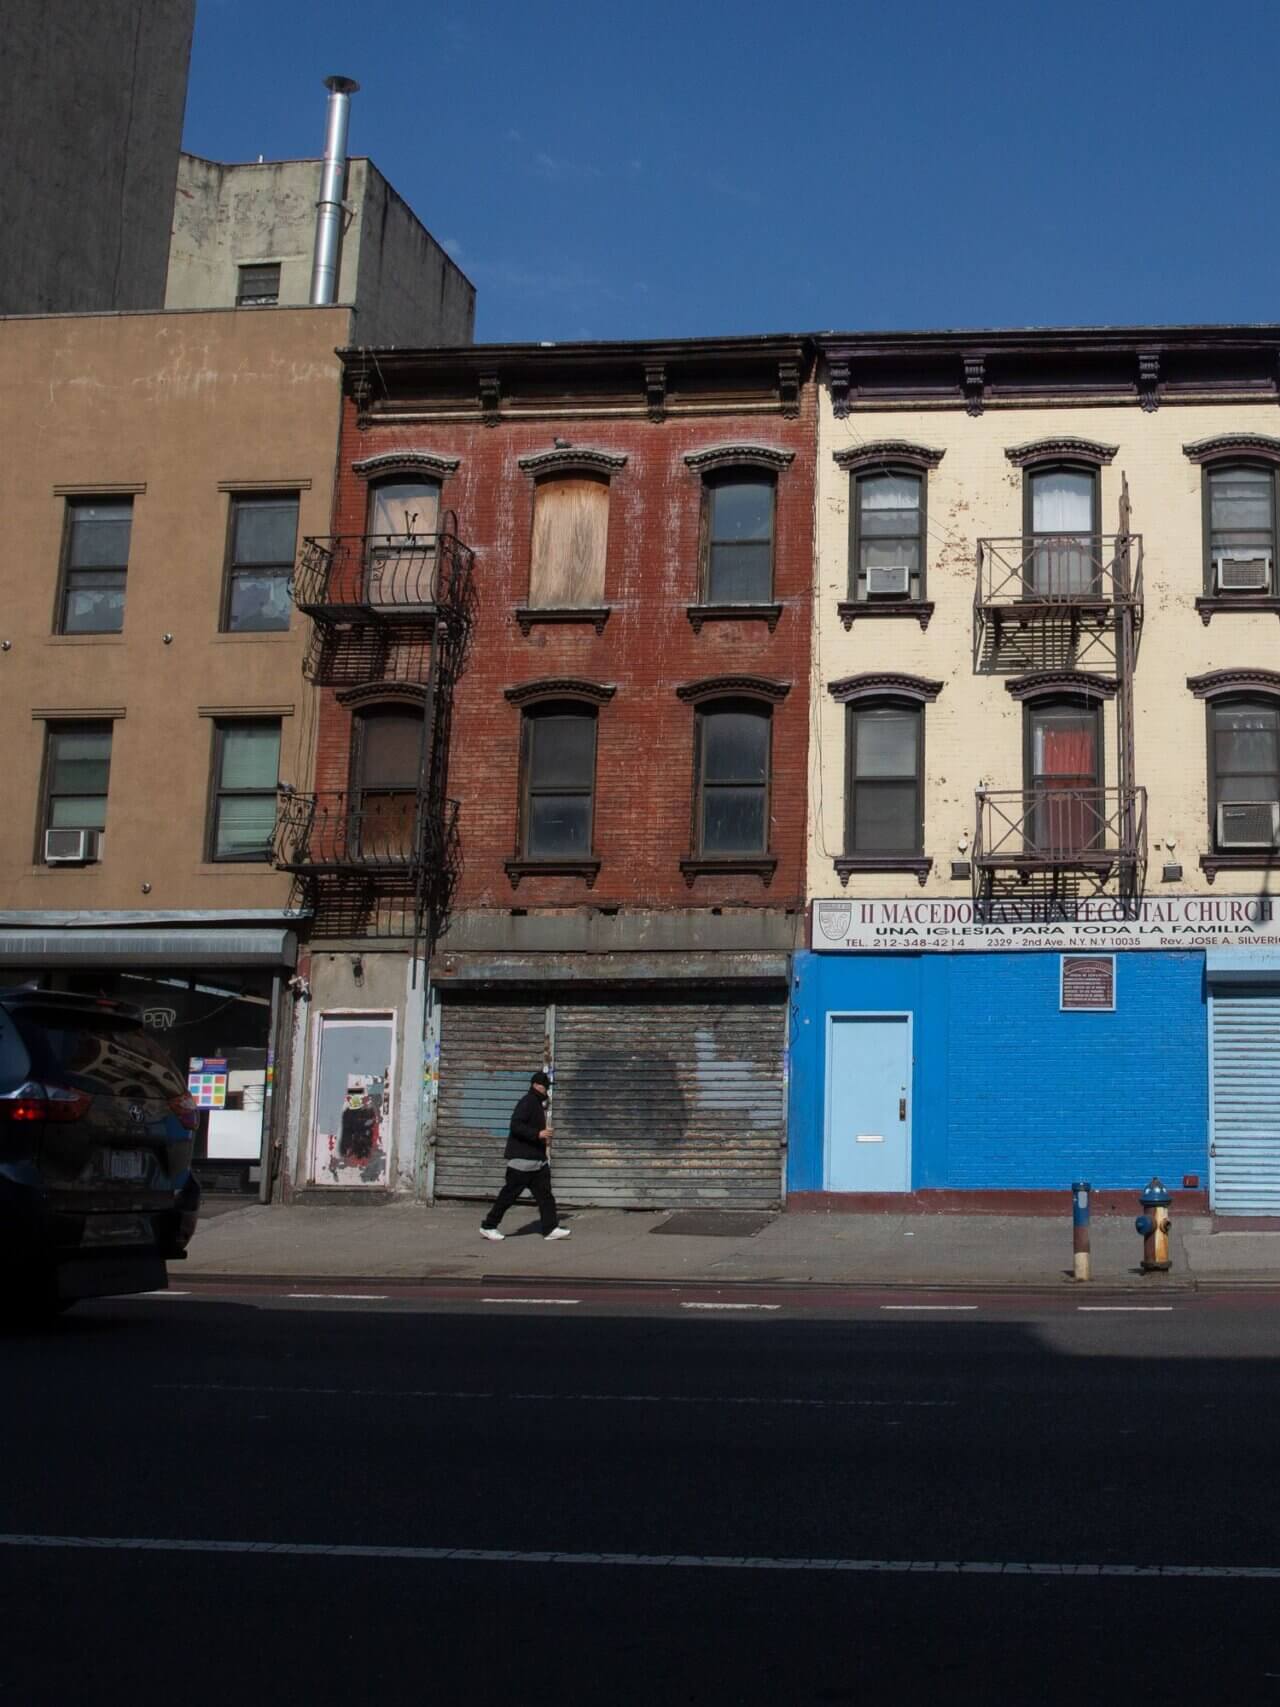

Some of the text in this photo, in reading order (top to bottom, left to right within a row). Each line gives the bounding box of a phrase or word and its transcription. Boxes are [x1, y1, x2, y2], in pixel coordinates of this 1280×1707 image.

[1184, 900, 1275, 922] CHURCH
[876, 925, 1255, 936] UNA IGLESIA PARA TODA LA FAMILIA
[845, 939, 868, 947] TEL.
[873, 938, 966, 947] 212-348-4214
[987, 938, 1012, 947] 2329
[1022, 938, 1042, 947] 2nd
[1043, 938, 1066, 947] Ave.
[1110, 937, 1141, 946] 10035
[1160, 936, 1184, 945] Rev.
[143, 1011, 173, 1028] PEN
